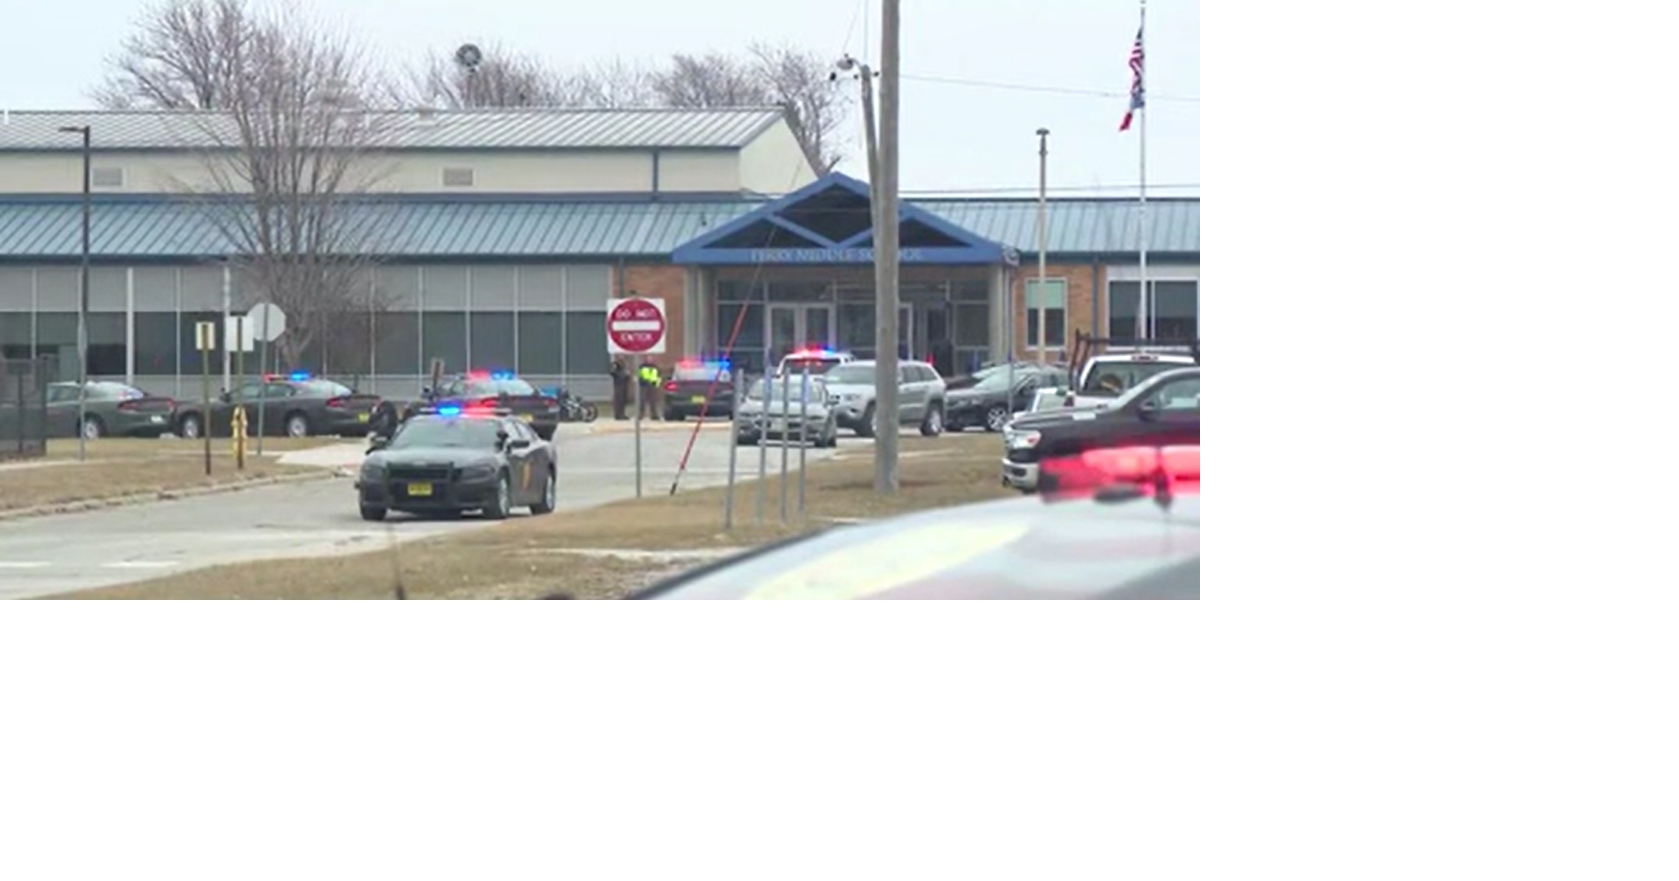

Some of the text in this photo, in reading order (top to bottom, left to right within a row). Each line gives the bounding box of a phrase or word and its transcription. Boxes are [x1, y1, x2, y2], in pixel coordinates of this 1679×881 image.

[795, 249, 854, 261] MIDDLE
[615, 308, 657, 318] DO NOT
[620, 333, 652, 342] ENTER
